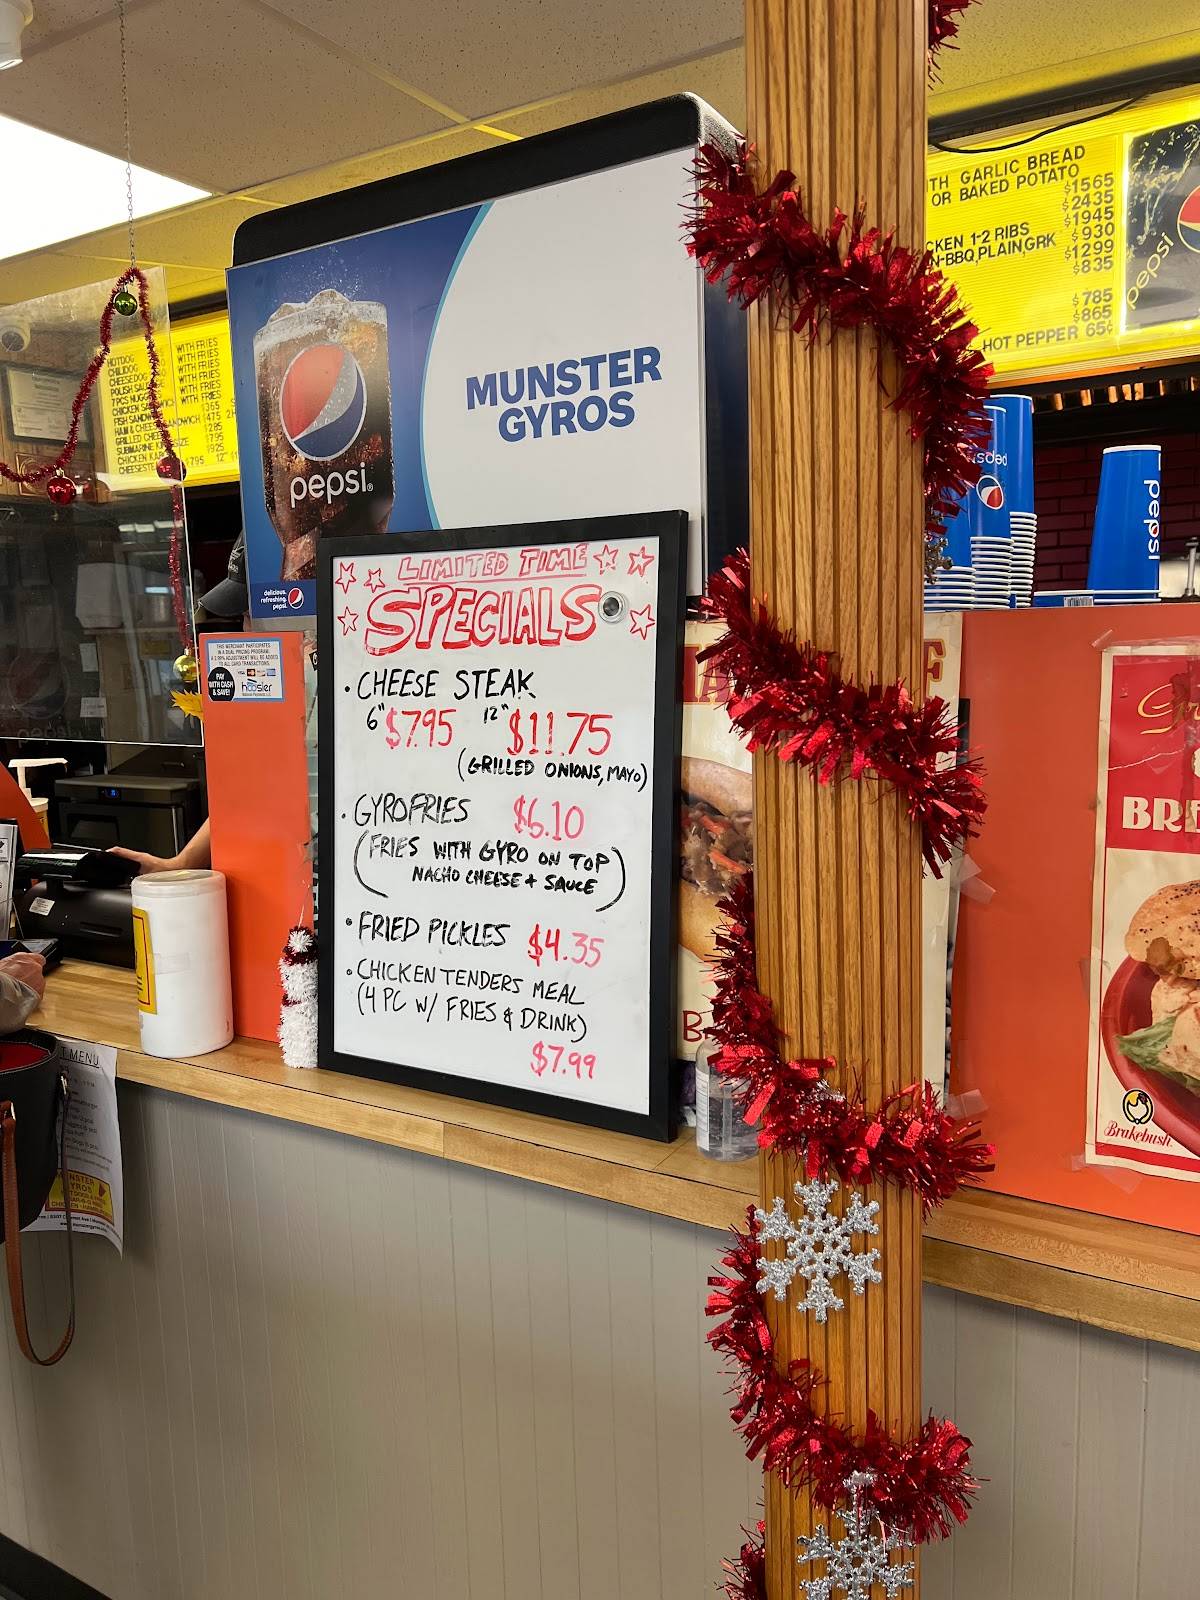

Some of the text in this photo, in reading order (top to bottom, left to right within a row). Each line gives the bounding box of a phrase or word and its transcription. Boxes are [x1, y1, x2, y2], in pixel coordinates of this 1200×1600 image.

[926, 145, 1086, 192] TH GARLIC BREAD
[931, 164, 1080, 207] OR BAKED POTATO
[1064, 172, 1114, 195] $1565
[1062, 190, 1114, 213] $2435
[926, 206, 1114, 253] CKEN 1-2 RIBS $1945
[1071, 222, 1115, 243] $930
[1064, 239, 1114, 261] $1299
[1072, 256, 1113, 275] $835
[1126, 232, 1174, 311] pepsi
[1072, 288, 1113, 307] $785
[1073, 304, 1113, 323] $865
[982, 335, 1012, 352] HOT
[1016, 324, 1079, 347] PEPPER
[107, 337, 218, 368] HOTDOG WITH FRIES
[177, 353, 196, 364] WITH
[197, 348, 219, 360] FRIES
[178, 363, 197, 374] WITH
[198, 358, 220, 370] FRIES
[111, 385, 132, 398] POLISH
[179, 373, 198, 385] WITH
[199, 369, 221, 381] FRIES
[180, 384, 199, 395] WITH
[200, 379, 221, 391] FRIES
[465, 346, 662, 410] MUNSTER
[112, 404, 140, 417] CHICKEN
[181, 393, 200, 405] WITH
[202, 390, 223, 401] FRIES
[498, 391, 636, 443] GYROS
[113, 416, 128, 427] FISH
[114, 426, 129, 437] HAM
[116, 434, 142, 446] GRILLED
[118, 455, 147, 466] CHICKEN
[1143, 479, 1160, 560] pepsi
[397, 543, 590, 582] LIMITED TIME
[364, 584, 603, 656] SPECIALS
[221, 680, 234, 689] CASH
[241, 680, 273, 692] hoosier
[357, 668, 537, 701] CHEESE STEAK
[513, 795, 585, 841] $6.10
[432, 840, 473, 862] WITH
[478, 839, 530, 865] GYRO
[538, 850, 562, 867] ON
[411, 866, 460, 883] NACHO
[465, 868, 523, 889] CHEESE
[524, 876, 537, 889] +
[357, 910, 605, 968] FRIED PICKLES $4.35
[357, 957, 585, 1006] CHICKEN TENDERS MEAL
[383, 986, 407, 1013] PC
[446, 996, 498, 1023] FRIES
[503, 1006, 513, 1032] &
[69, 1048, 99, 1066] MENU
[530, 1040, 598, 1079] $7.99
